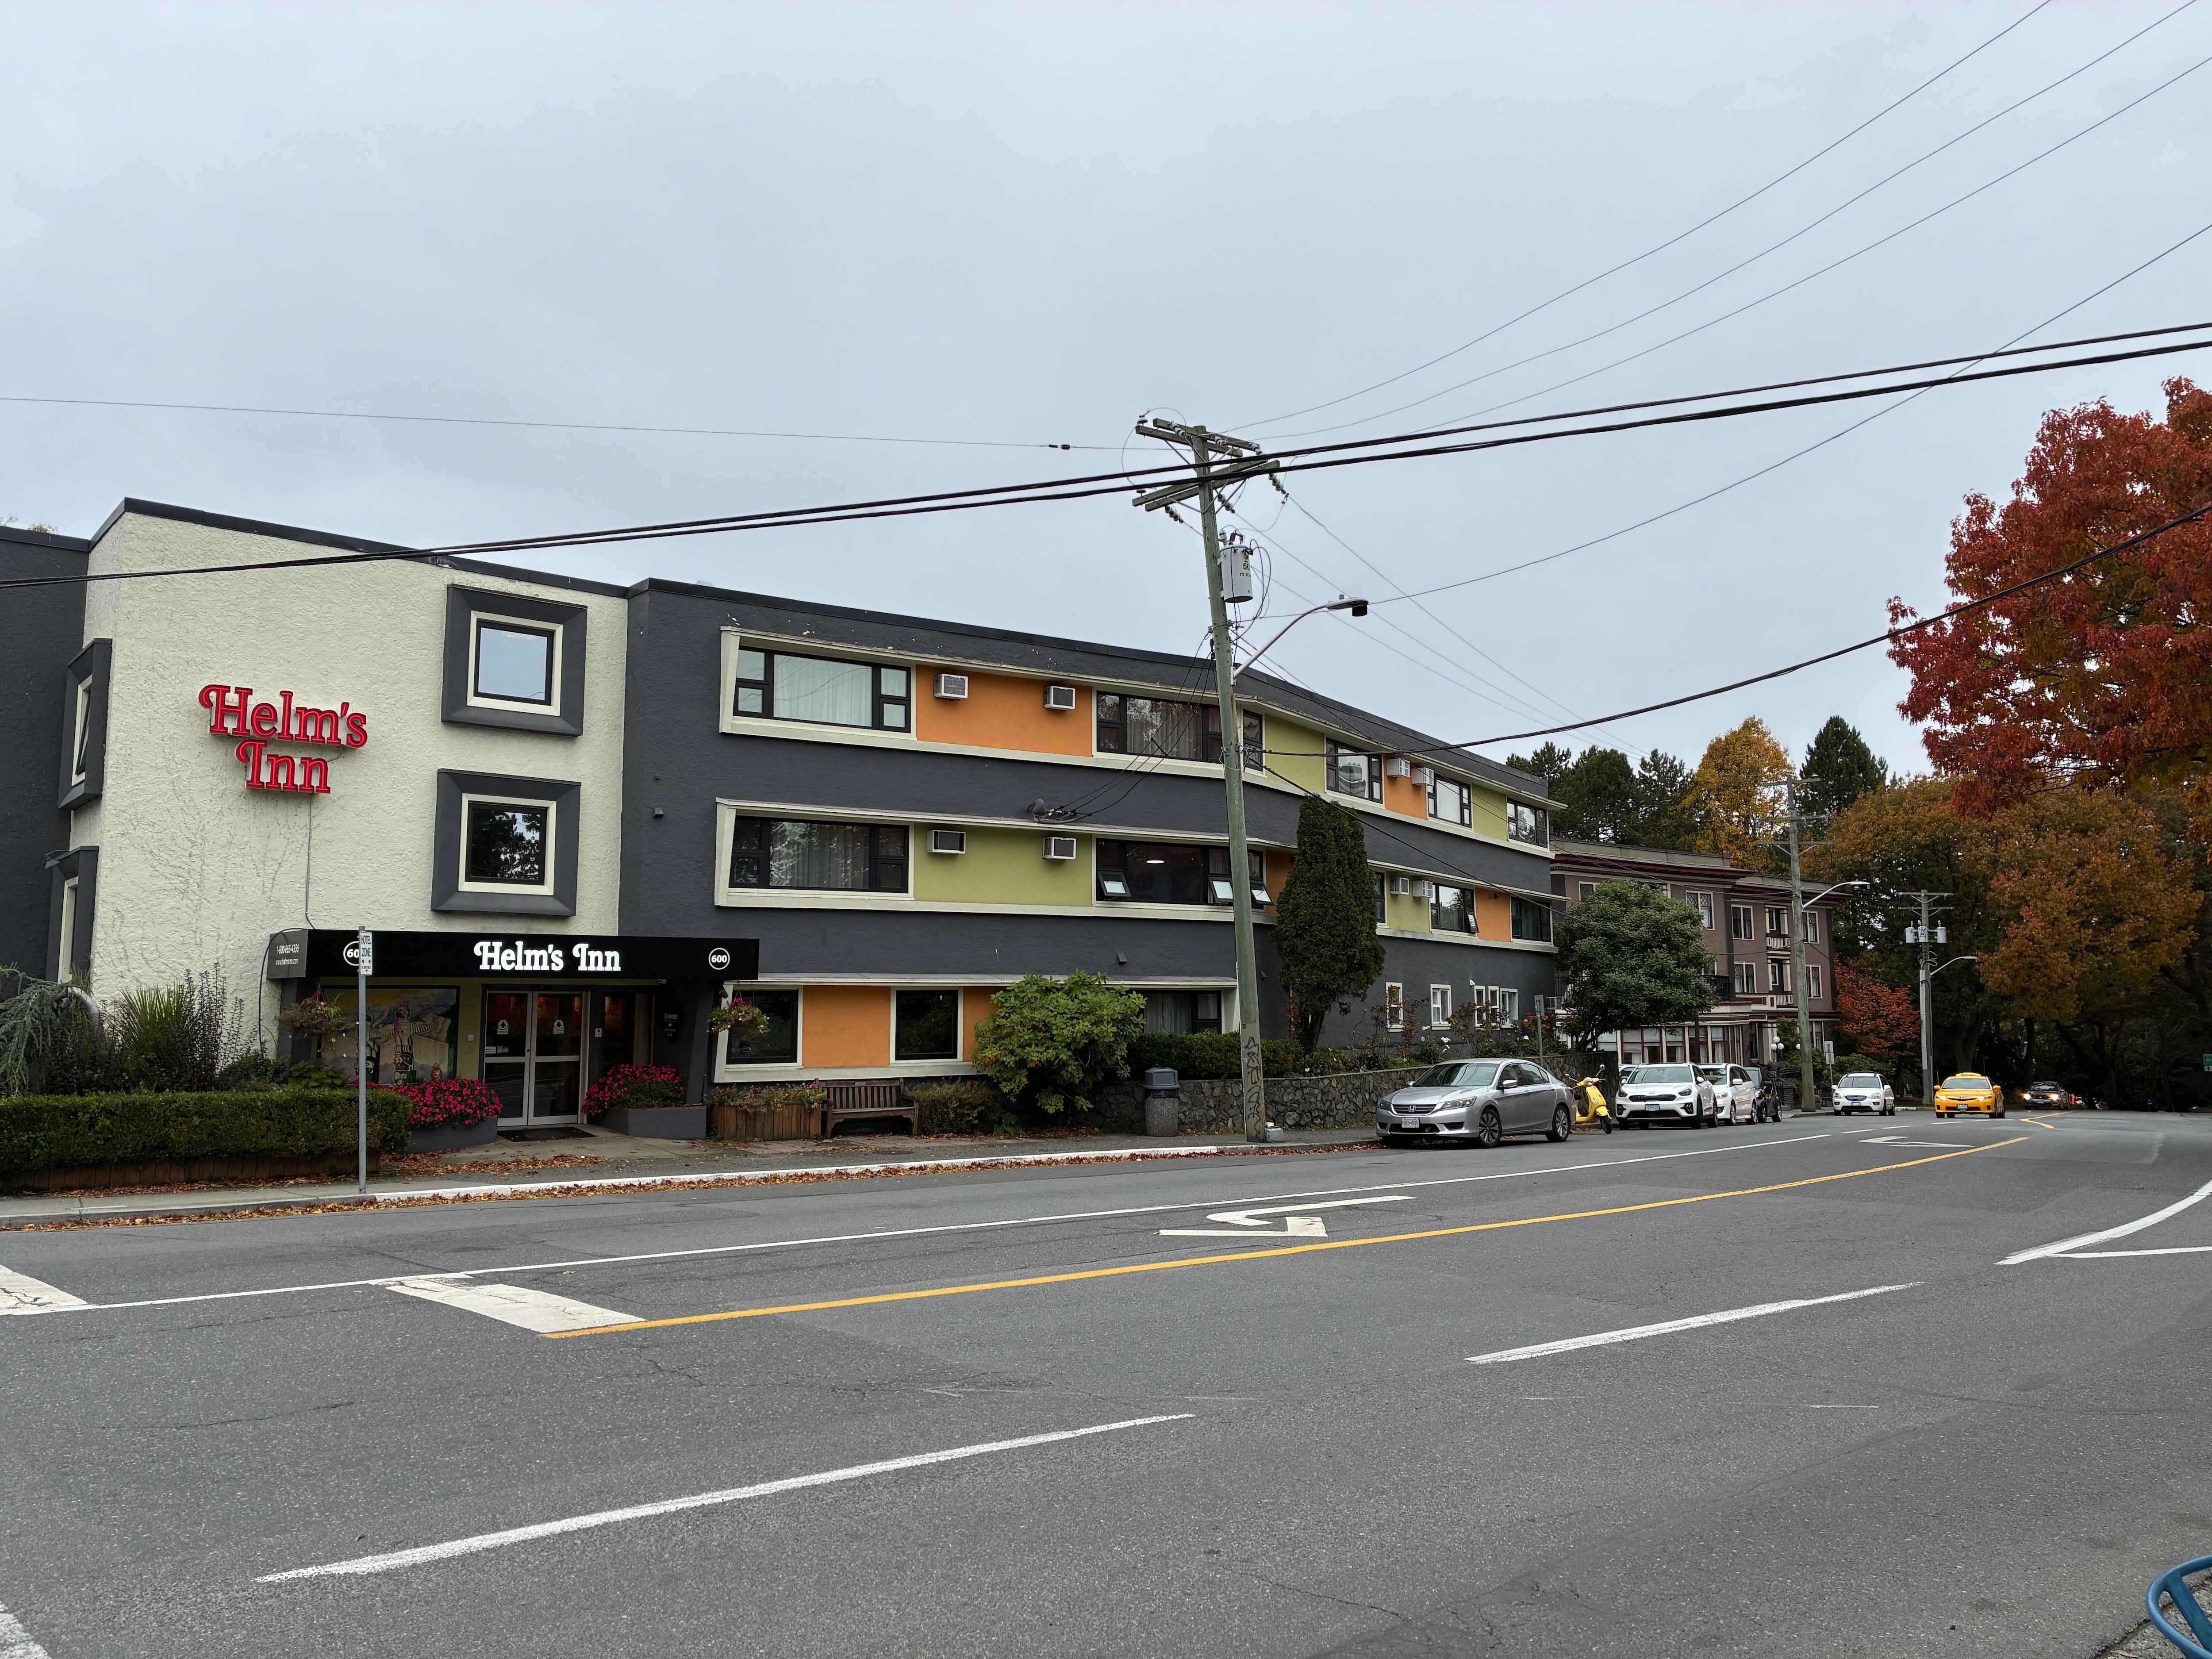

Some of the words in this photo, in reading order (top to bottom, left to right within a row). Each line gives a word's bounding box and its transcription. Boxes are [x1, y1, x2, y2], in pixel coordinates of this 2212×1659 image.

[199, 684, 368, 748] Helm's
[235, 739, 331, 794] Inn
[361, 935, 371, 945] HOTEL
[347, 949, 359, 958] 60
[362, 947, 371, 957] ZONE
[473, 941, 564, 971] Helm's
[572, 943, 621, 971] Inn
